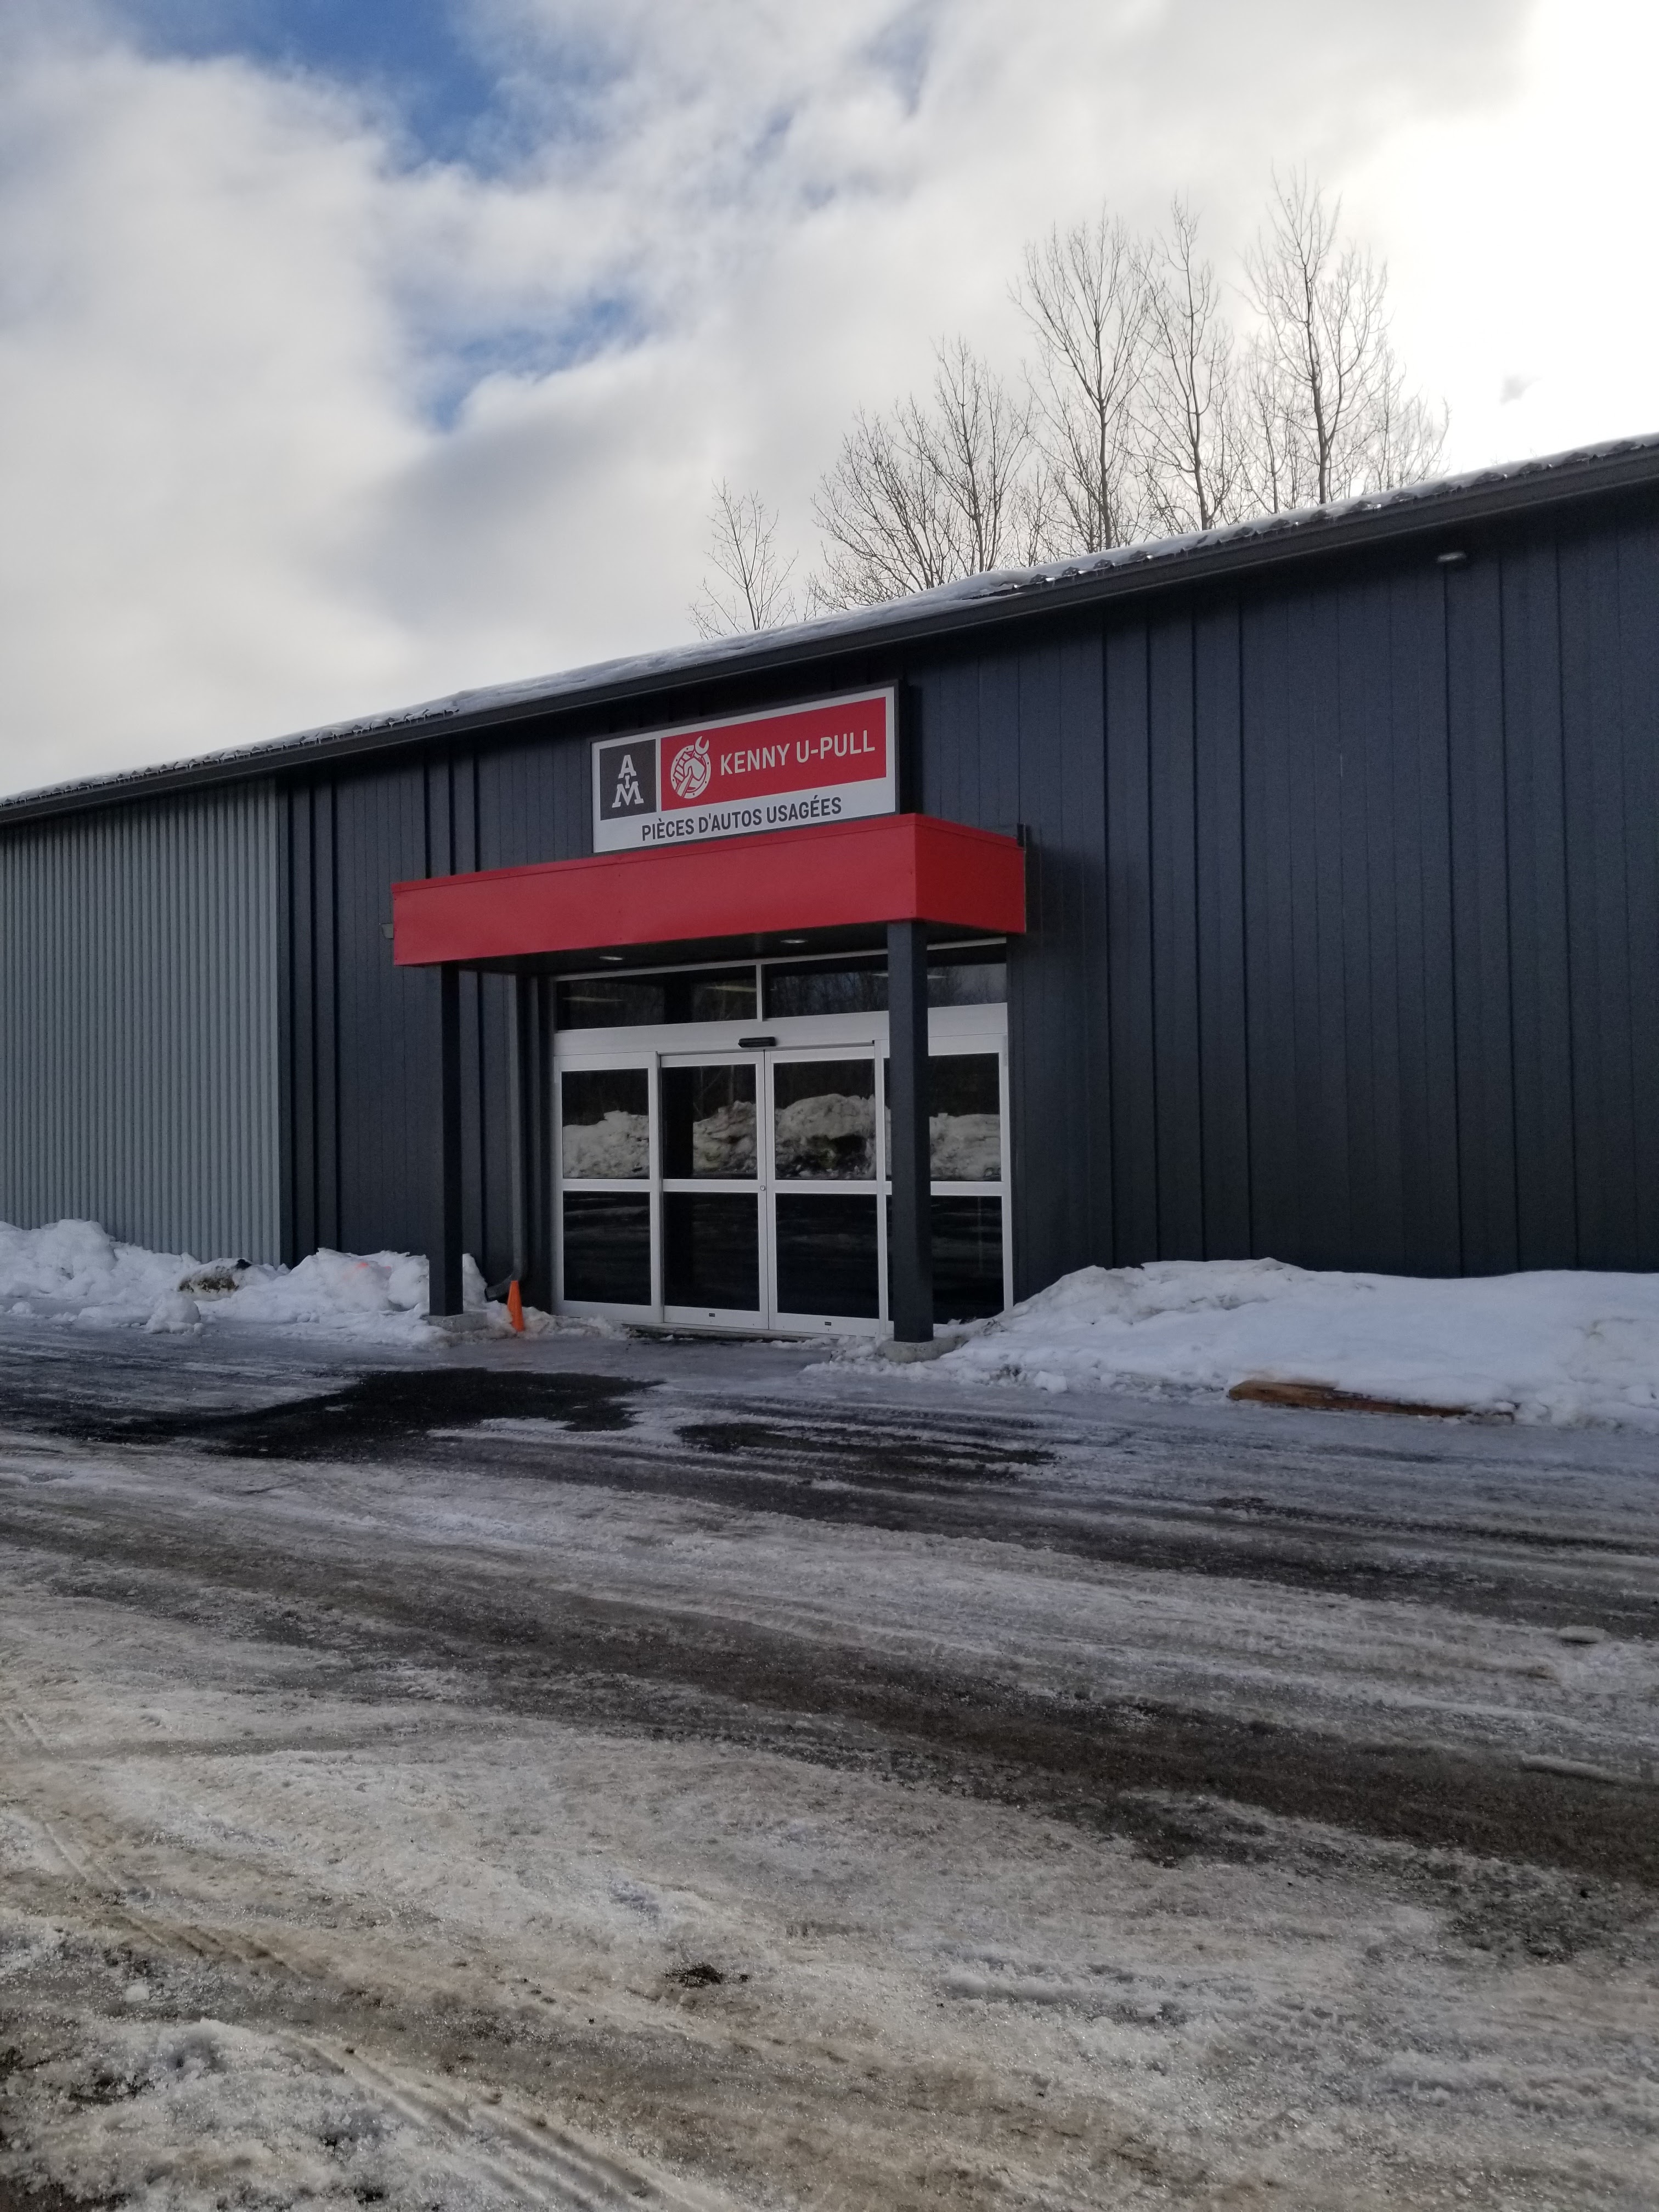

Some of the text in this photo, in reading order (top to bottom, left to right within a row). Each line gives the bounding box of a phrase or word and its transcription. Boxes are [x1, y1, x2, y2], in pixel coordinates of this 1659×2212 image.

[720, 730, 876, 776] KENNY U-PULL
[642, 795, 842, 842] PIÈCES D'AUTOS USAGÉES
